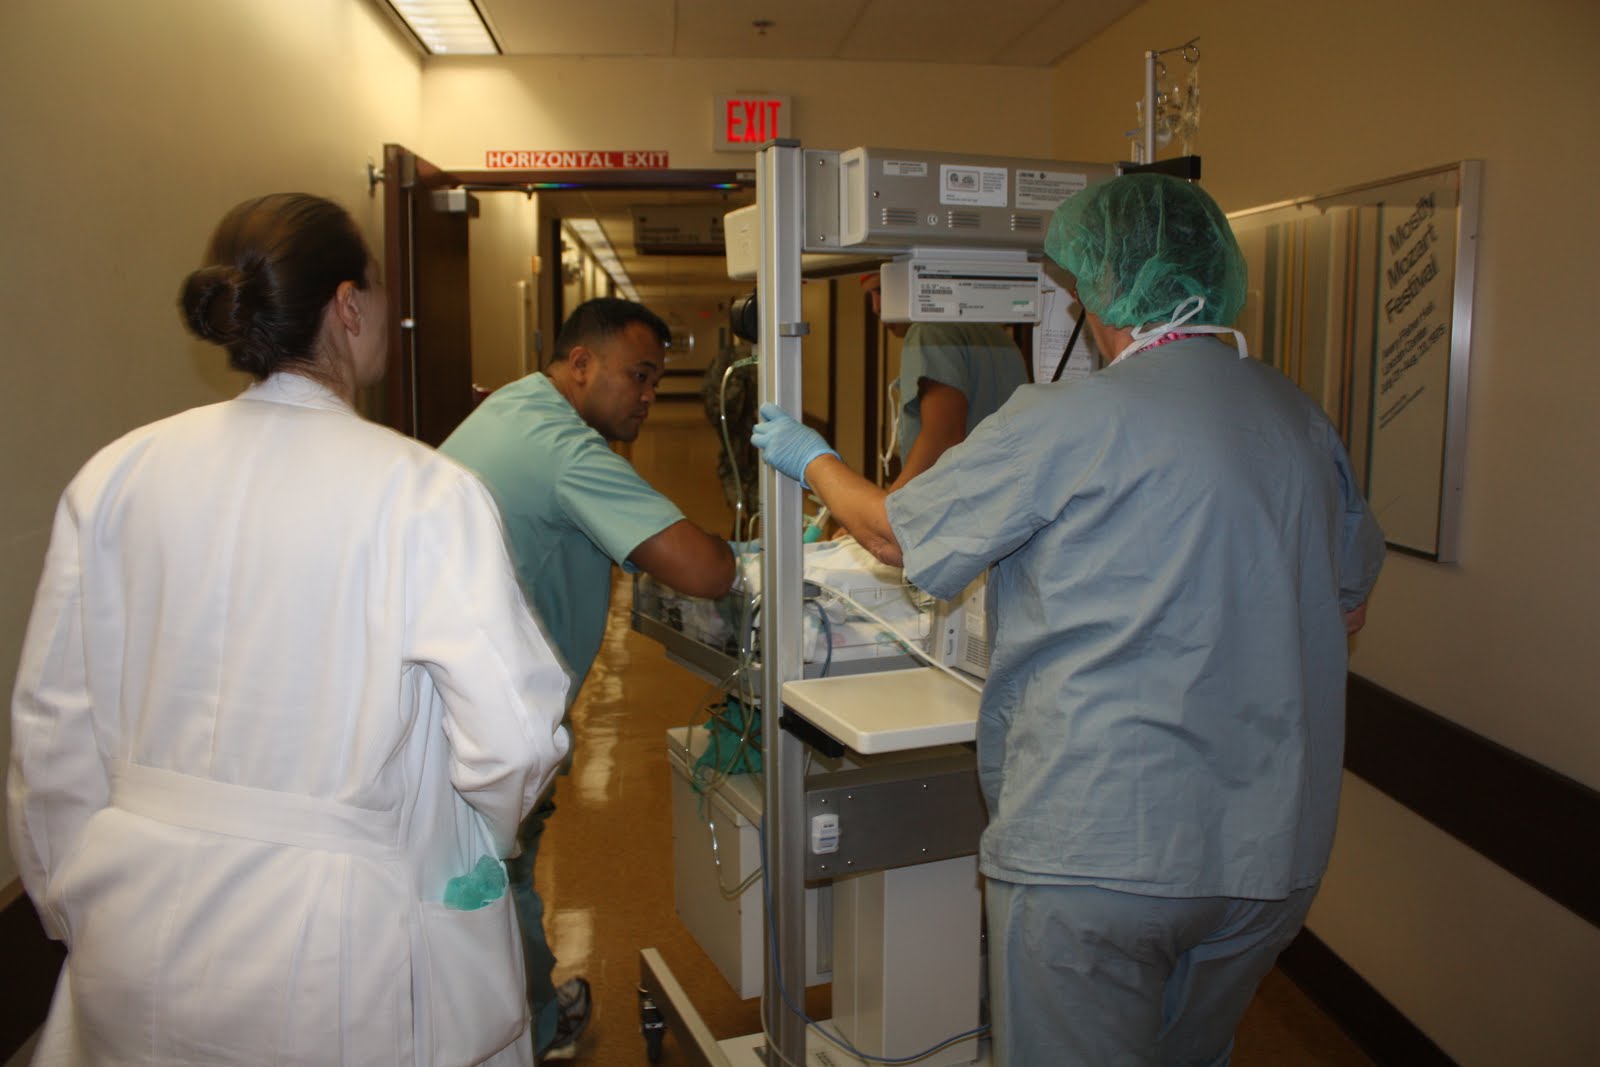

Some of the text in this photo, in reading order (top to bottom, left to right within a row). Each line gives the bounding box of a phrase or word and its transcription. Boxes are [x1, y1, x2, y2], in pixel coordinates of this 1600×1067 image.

[726, 100, 782, 144] EXIT
[486, 152, 668, 168] HORIZONTAL EXIT
[1387, 223, 1439, 291] Mozart
[1384, 253, 1440, 324] Festival
